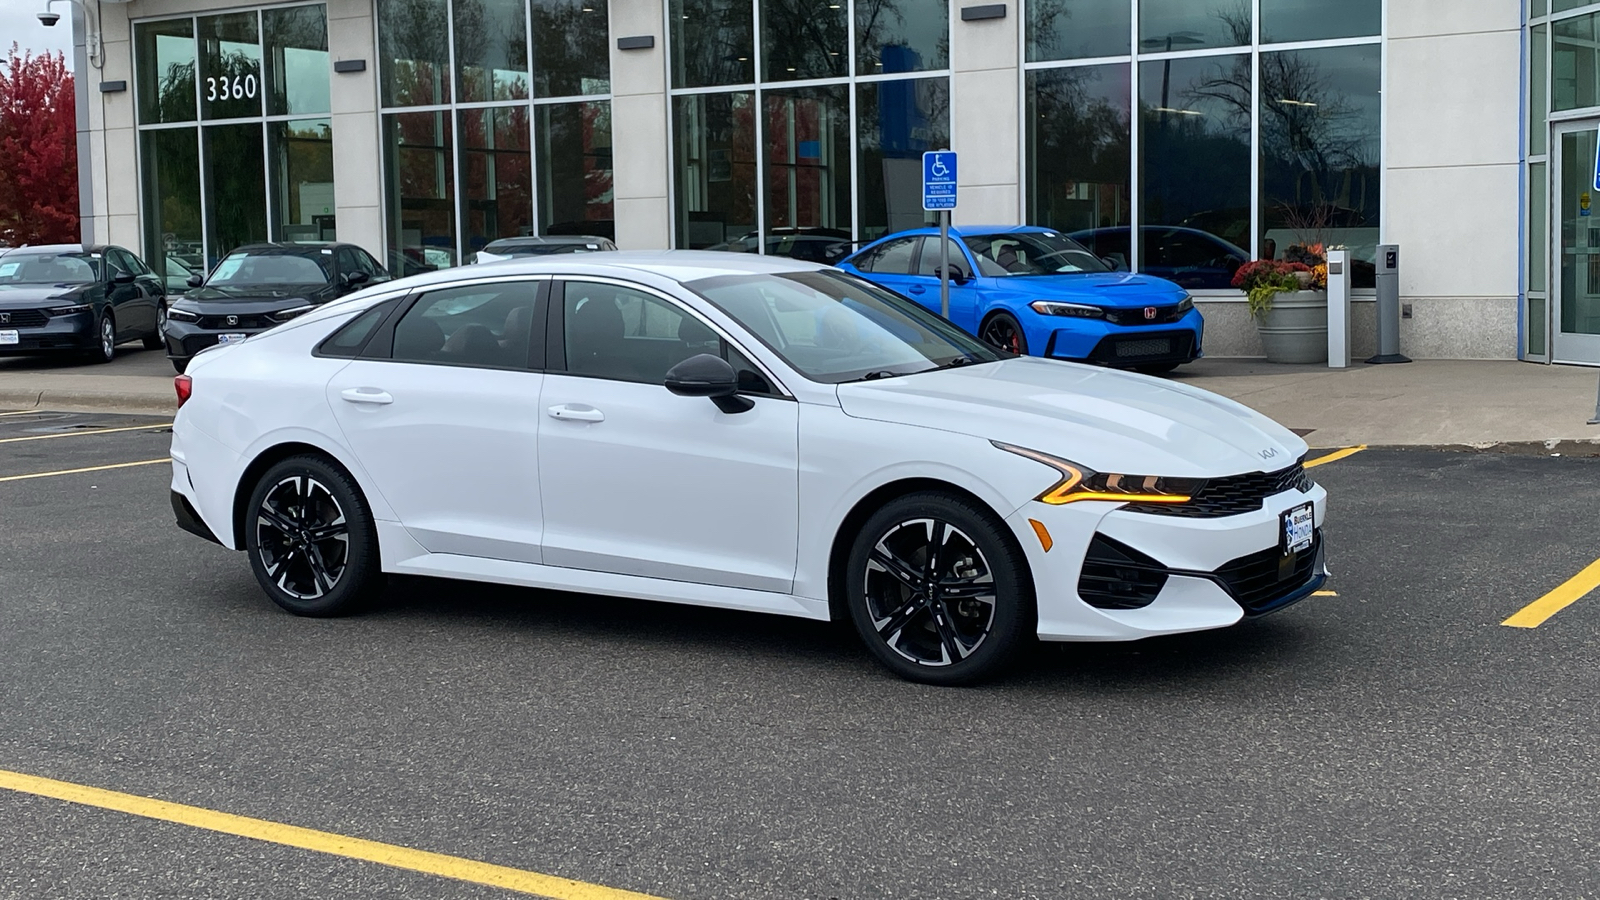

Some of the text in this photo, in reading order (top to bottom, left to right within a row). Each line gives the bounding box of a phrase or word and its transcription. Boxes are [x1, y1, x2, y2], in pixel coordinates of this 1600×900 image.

[207, 74, 256, 101] 3360
[1294, 512, 1312, 525] BUERKLE
[1294, 523, 1312, 541] HONDA
